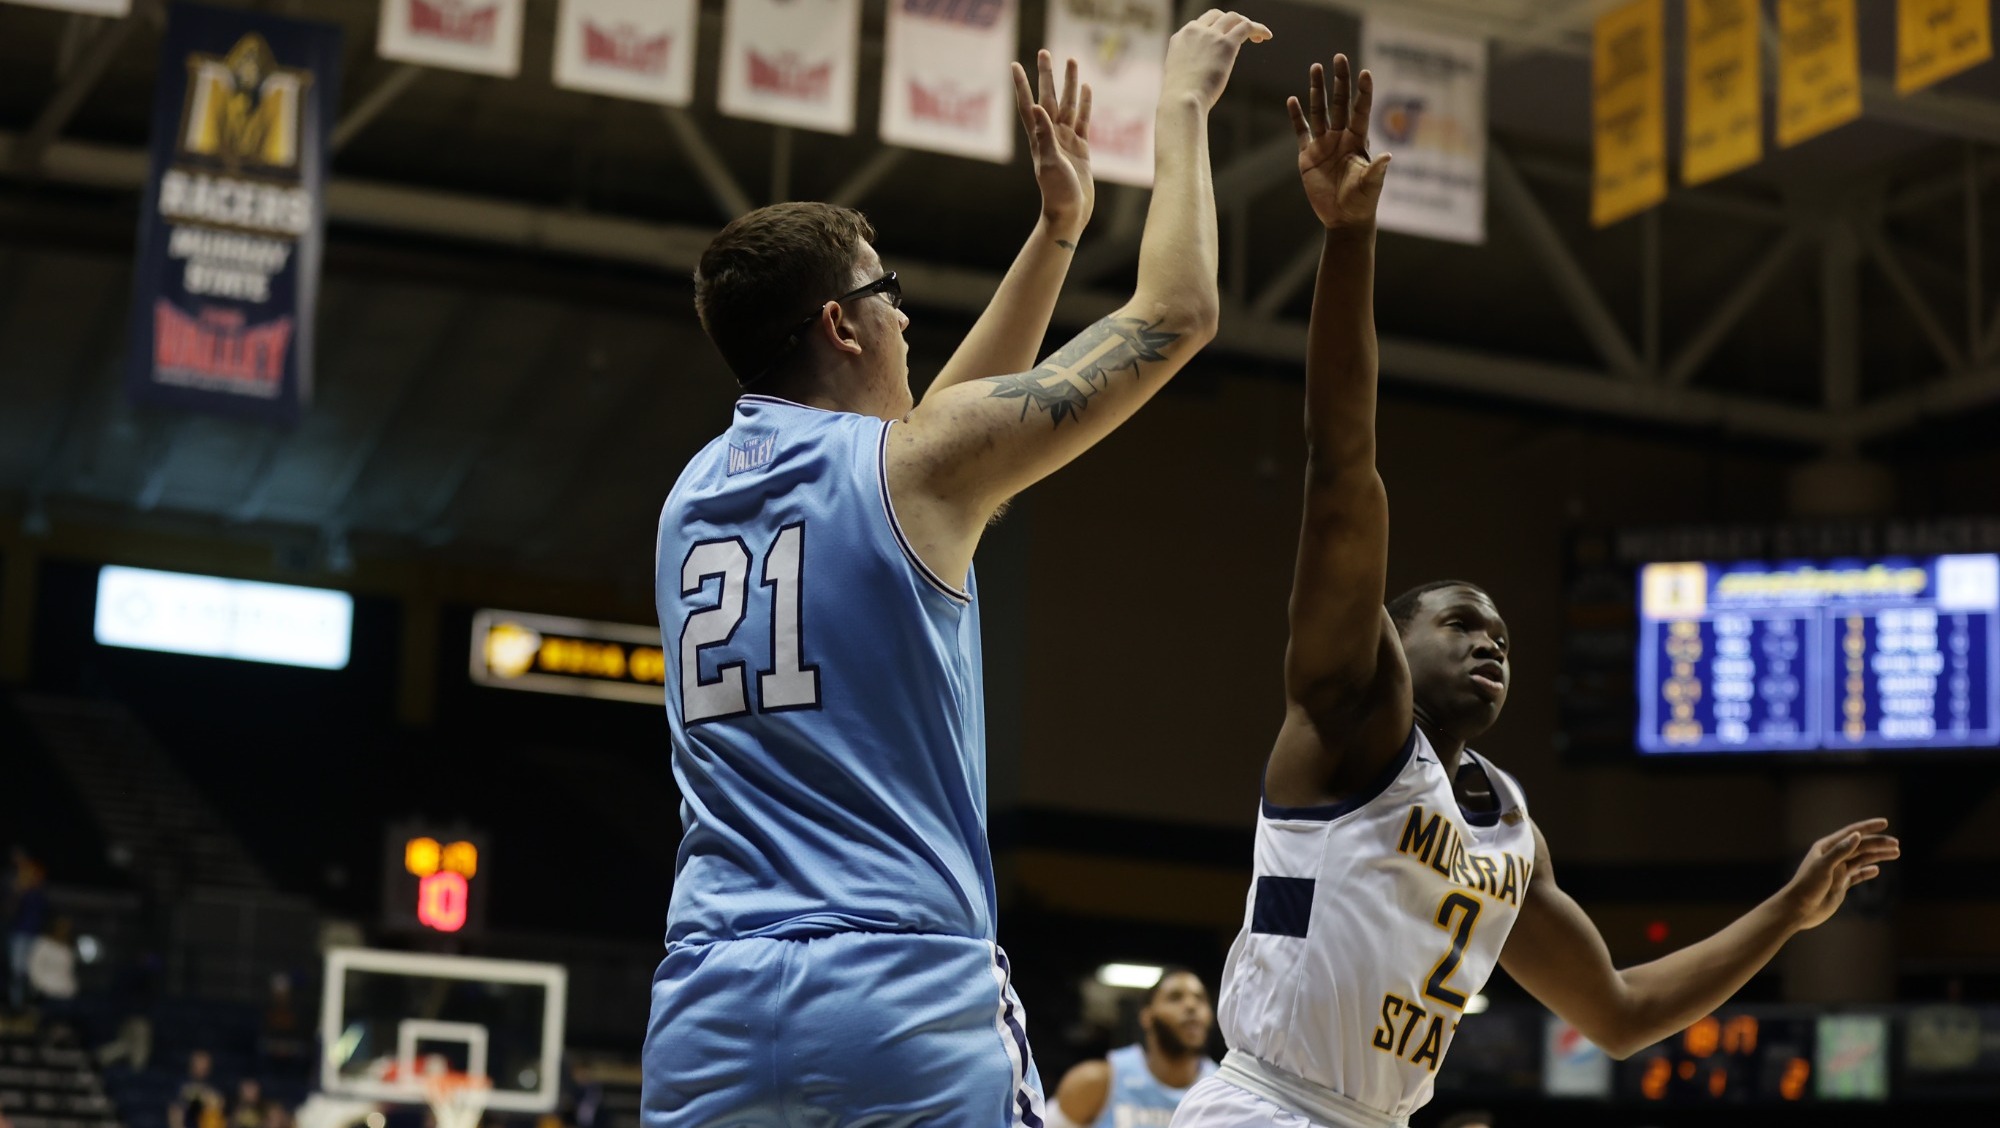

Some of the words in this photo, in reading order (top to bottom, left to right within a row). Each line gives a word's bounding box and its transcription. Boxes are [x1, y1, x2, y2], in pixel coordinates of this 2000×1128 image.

[158, 168, 312, 234] RACERS
[168, 227, 291, 273] MURRAY
[183, 260, 271, 303] STATE
[729, 432, 776, 474] VALLEY
[679, 520, 822, 726] 21
[1396, 804, 1531, 908] MURRAY
[1421, 889, 1483, 1012] 2
[1372, 991, 1458, 1073] STA
